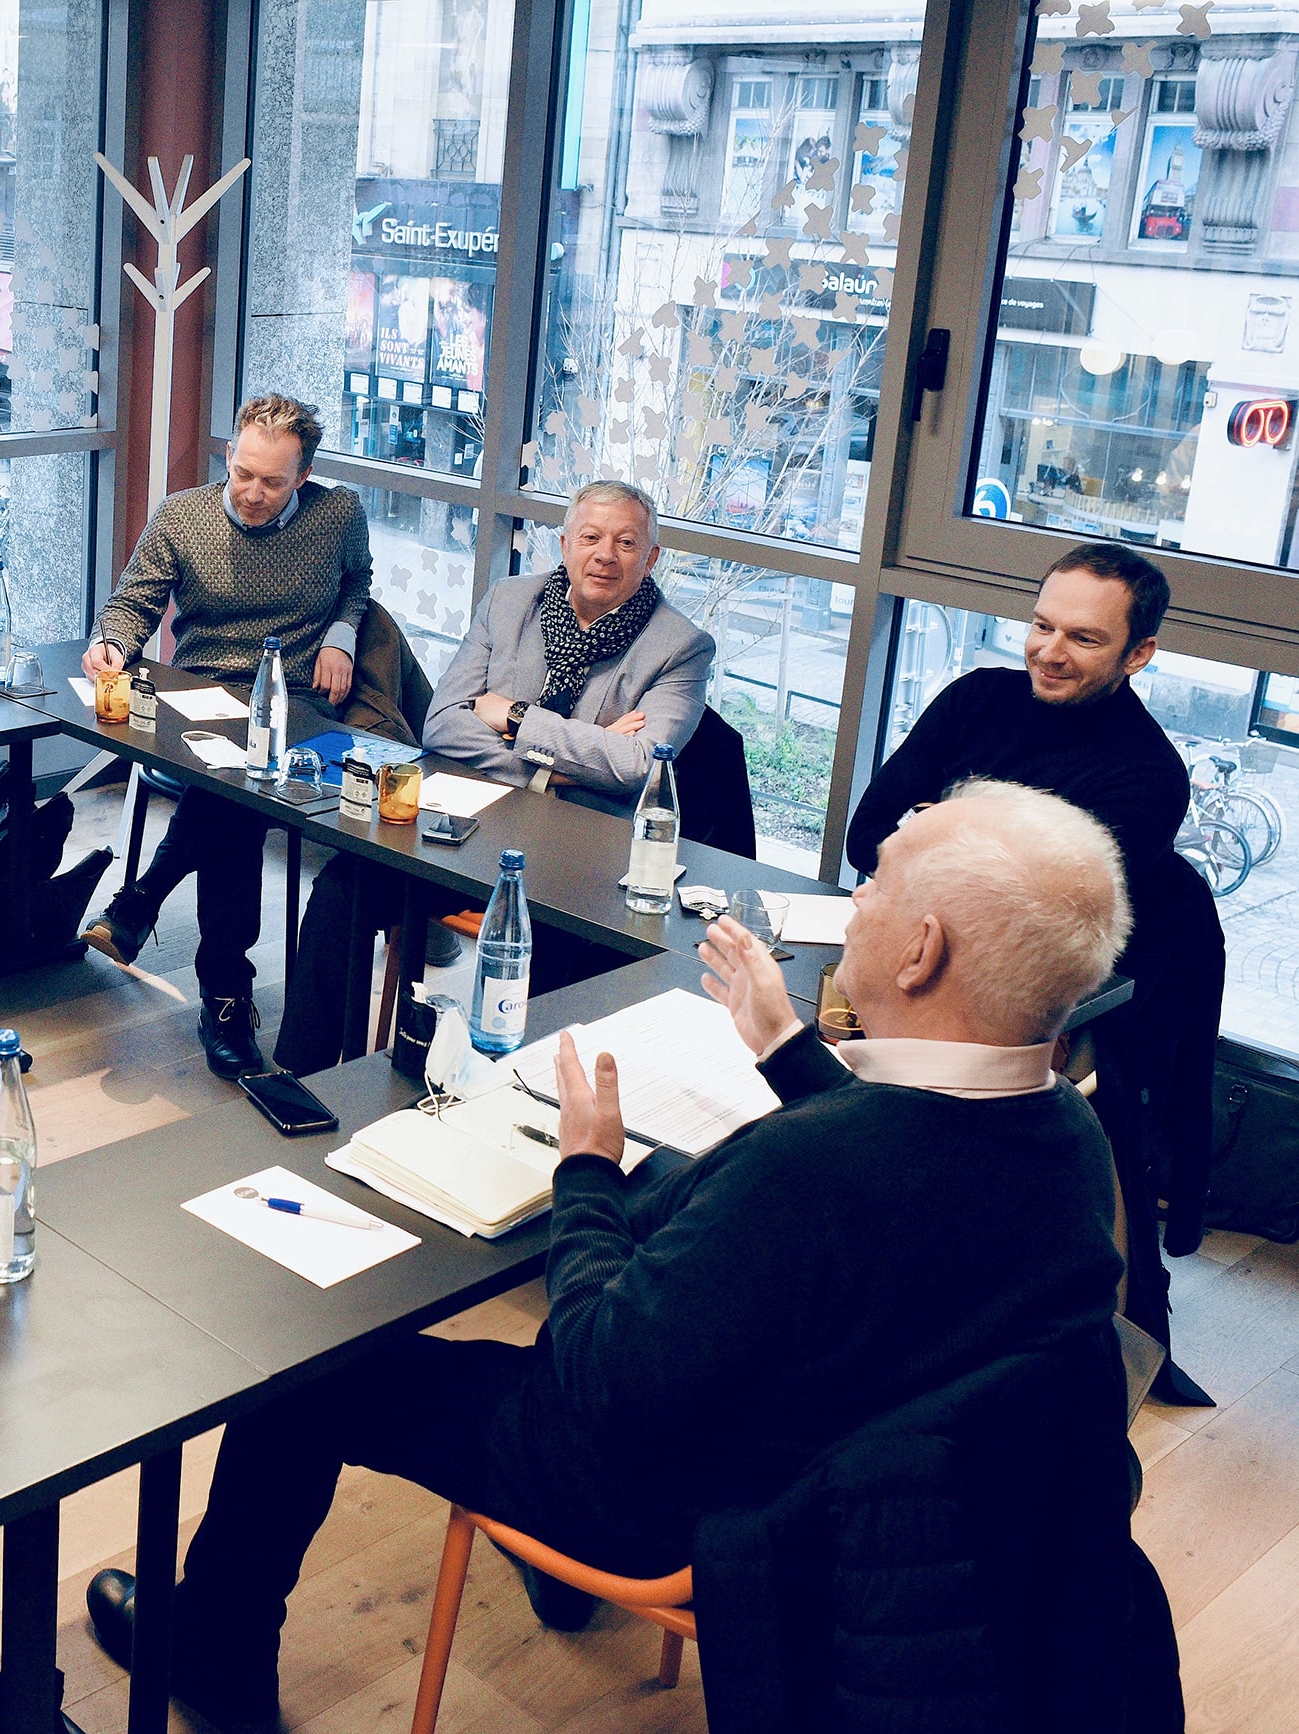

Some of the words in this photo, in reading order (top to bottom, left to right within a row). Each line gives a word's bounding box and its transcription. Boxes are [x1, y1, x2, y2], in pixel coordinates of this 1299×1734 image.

[381, 218, 499, 257] Saint-Exupér
[1017, 300, 1044, 309] voyages
[381, 327, 398, 339] ILS
[449, 333, 469, 346] LES
[380, 340, 409, 354] SONT
[440, 344, 477, 361] JEUNES
[437, 357, 478, 376] AMANTS
